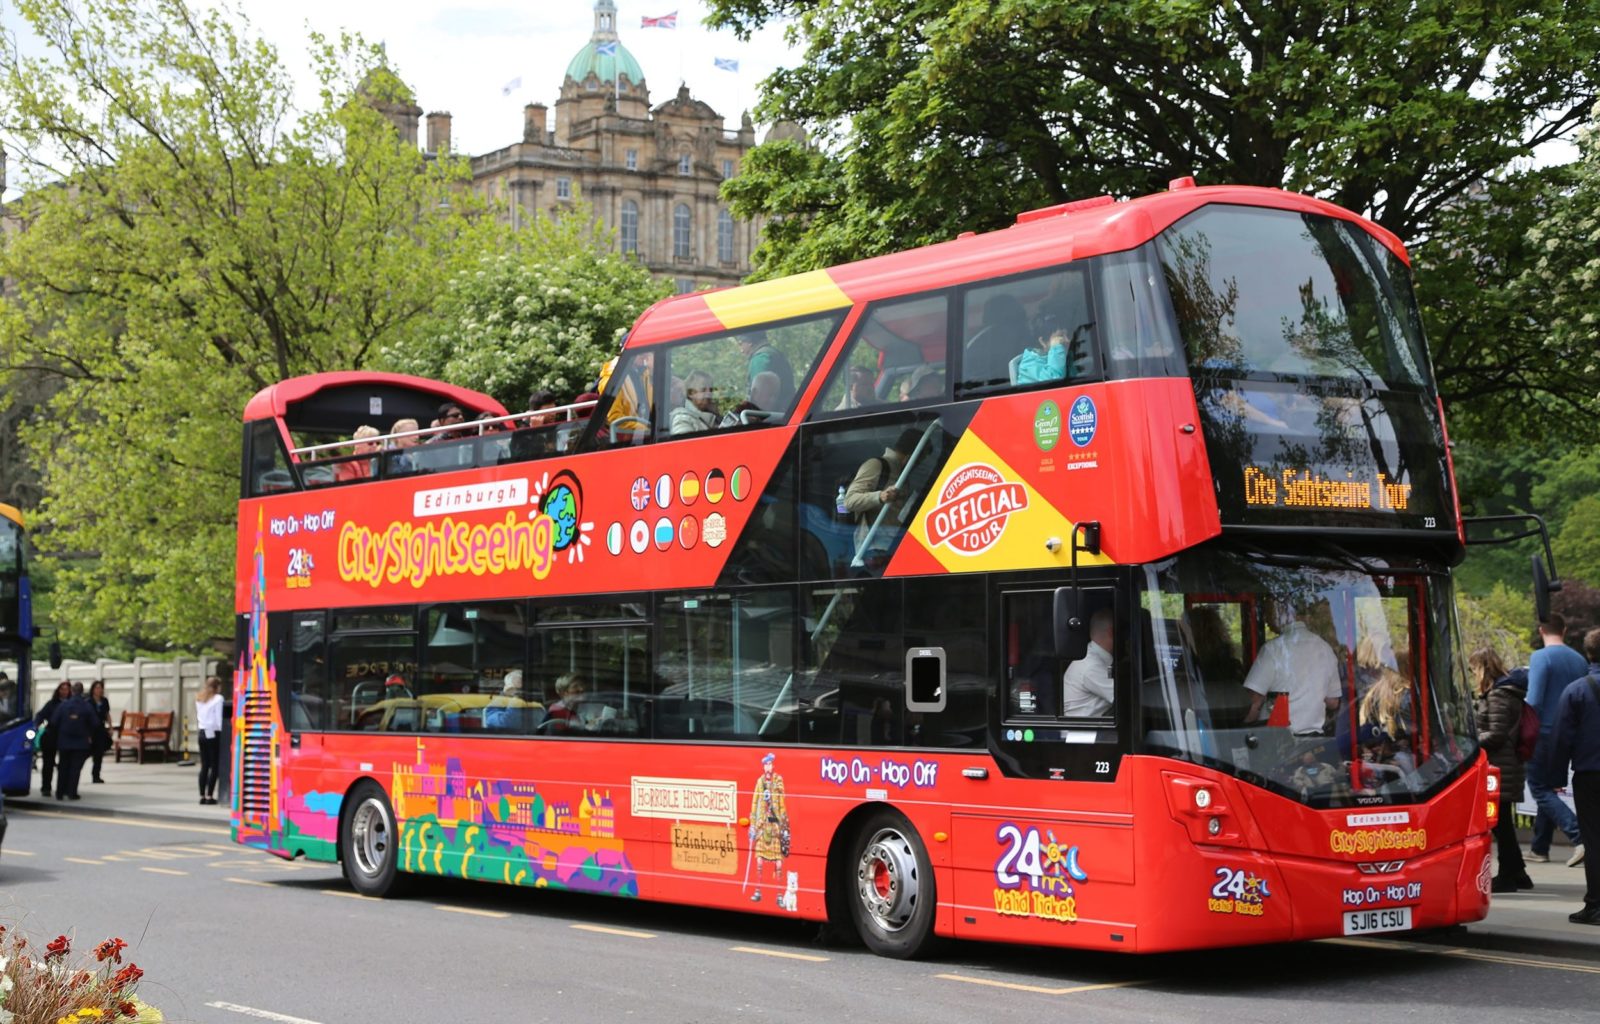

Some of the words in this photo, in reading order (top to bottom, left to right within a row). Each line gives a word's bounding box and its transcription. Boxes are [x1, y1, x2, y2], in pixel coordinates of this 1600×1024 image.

[424, 484, 517, 508] Edinburgh
[945, 469, 998, 499] CITYSIGHTSEEING
[1244, 467, 1276, 505] City
[1283, 469, 1371, 508] Sightseeing
[1376, 473, 1412, 509] Tour
[270, 518, 287, 537] Hop
[287, 515, 299, 534] On
[303, 513, 320, 532] Hop
[321, 510, 336, 529] Off
[935, 486, 1023, 537] OFFICIAL
[338, 511, 553, 588] CitySightseeing
[962, 521, 1002, 549] TOUR
[821, 758, 848, 784] Hop
[851, 758, 871, 783] On
[881, 760, 910, 787] Hop
[913, 760, 937, 786] Off
[1095, 761, 1110, 773] 223
[1353, 814, 1404, 823] Edinburgh
[674, 828, 734, 858] Edinburgh
[1331, 827, 1427, 854] CitySightseeing
[997, 825, 1043, 887] 24
[1212, 867, 1245, 899] 24
[1343, 889, 1364, 905] Hop
[1366, 887, 1380, 903] On
[1387, 885, 1406, 900] Hop
[1407, 882, 1421, 899] Off
[994, 888, 1030, 916] Valid
[1032, 890, 1077, 922] Ticket
[1351, 912, 1378, 931] SJ16
[1381, 910, 1404, 929] CSU
